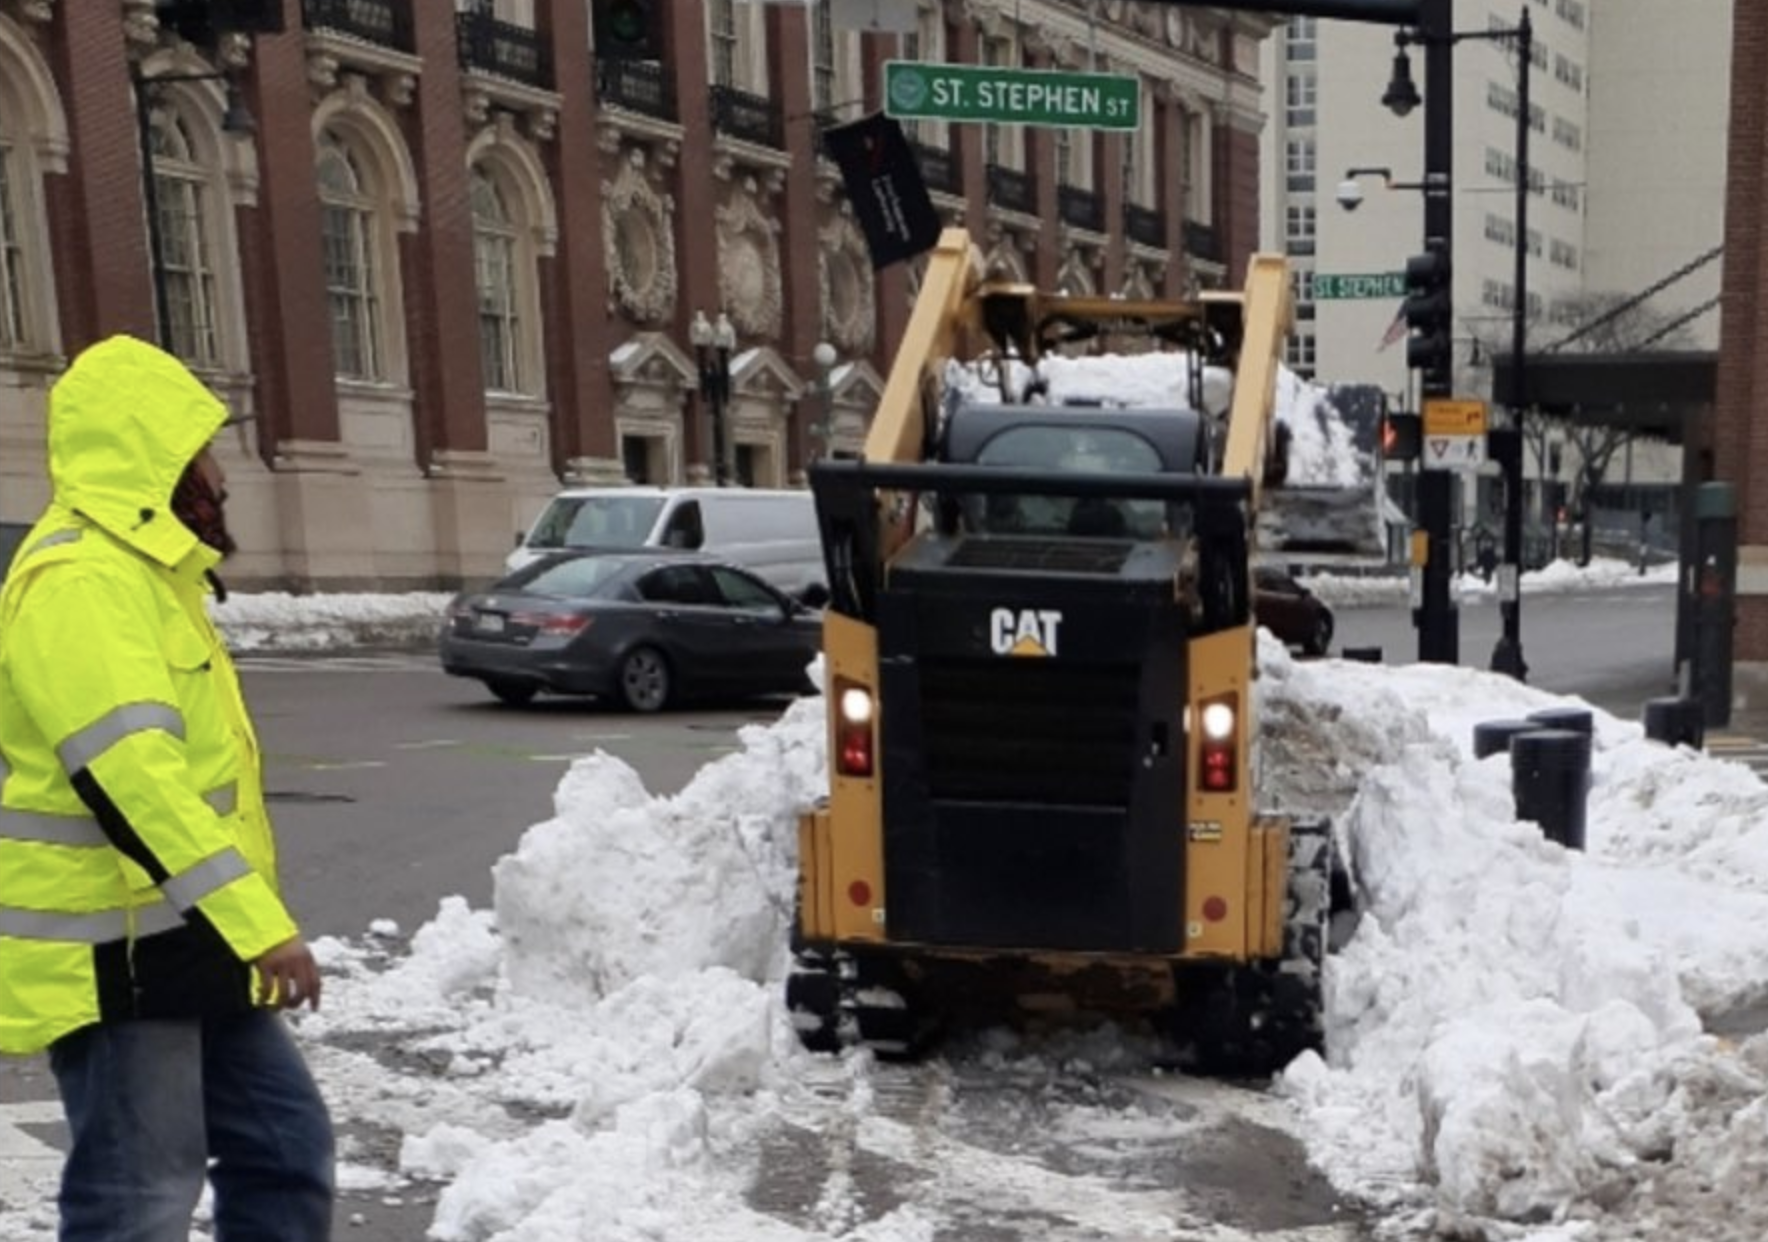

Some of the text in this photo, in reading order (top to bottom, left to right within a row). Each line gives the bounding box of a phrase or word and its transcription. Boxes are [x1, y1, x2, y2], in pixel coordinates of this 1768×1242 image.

[931, 78, 1129, 117] ST. STEPHEN ST
[1338, 275, 1404, 297] STEPHEN
[990, 606, 1062, 657] CAT
